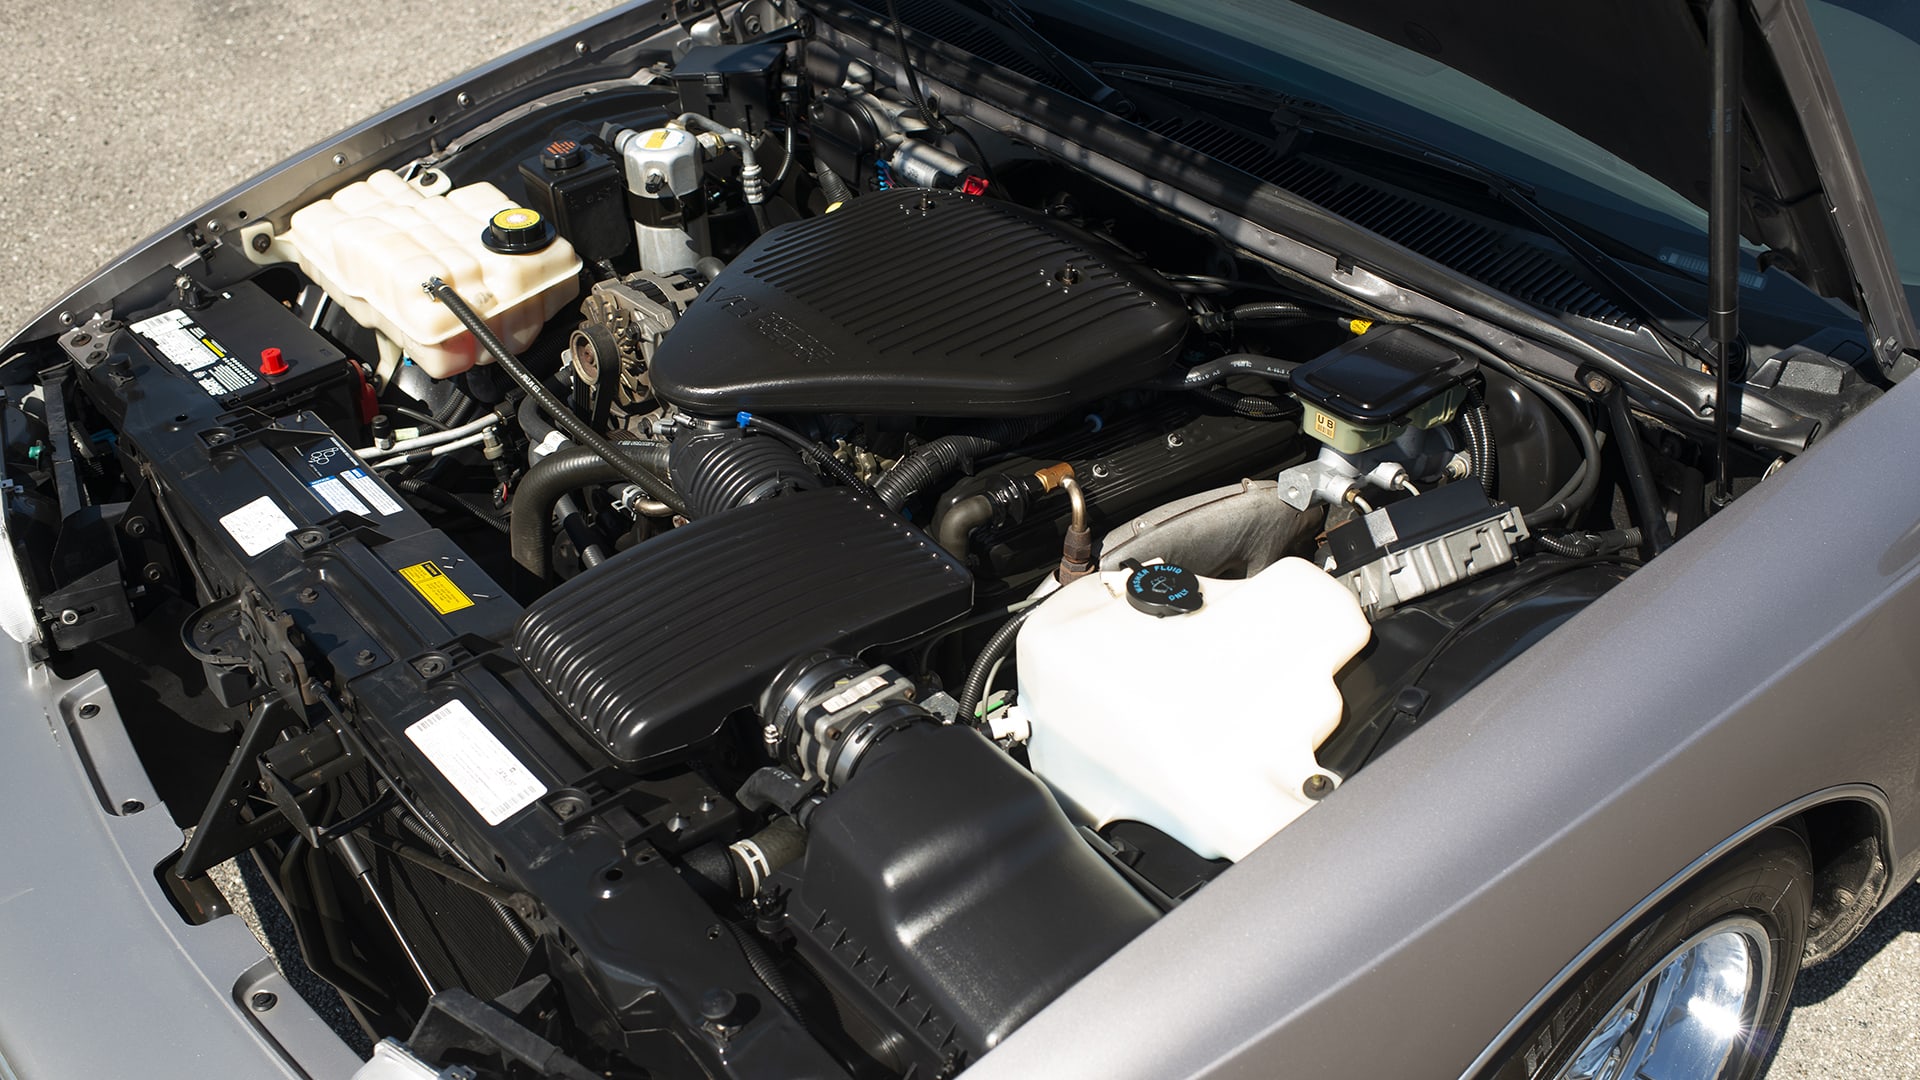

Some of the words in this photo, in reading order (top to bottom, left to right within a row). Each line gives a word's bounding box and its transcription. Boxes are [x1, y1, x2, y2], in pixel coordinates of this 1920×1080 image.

[1132, 568, 1150, 593] WASHER
[1153, 565, 1183, 575] FLUID
[1167, 588, 1190, 602] ONLY
